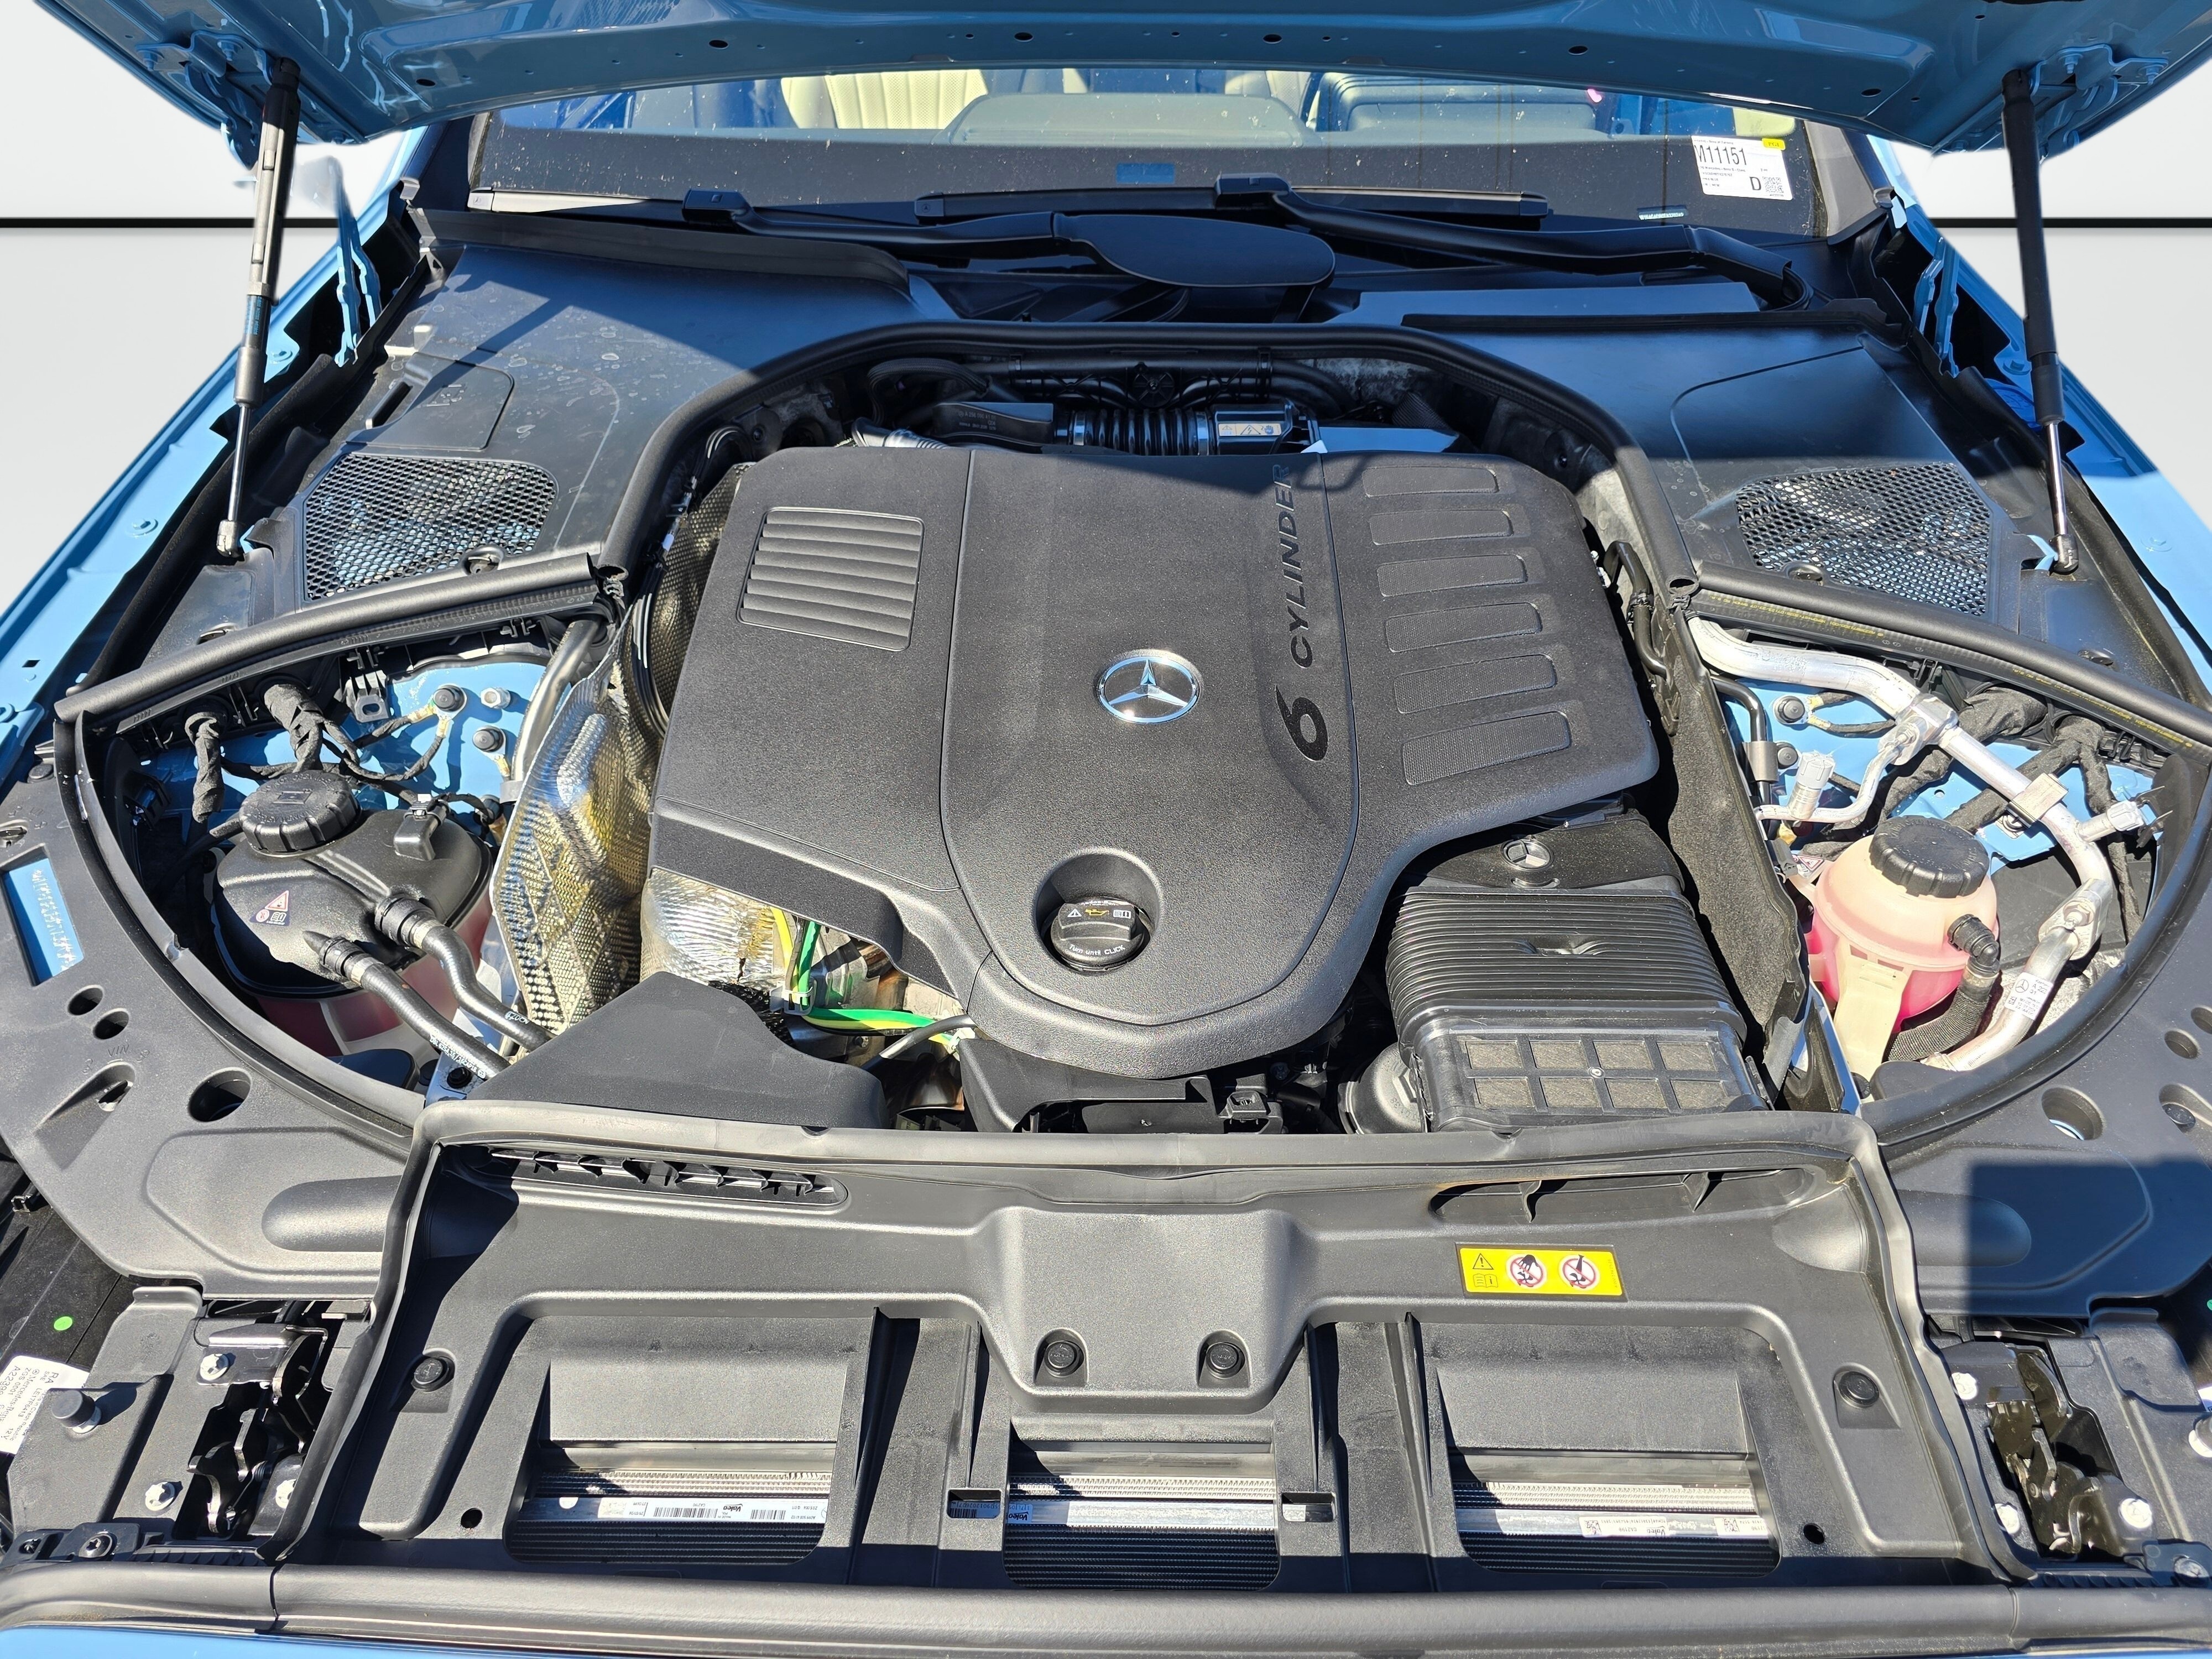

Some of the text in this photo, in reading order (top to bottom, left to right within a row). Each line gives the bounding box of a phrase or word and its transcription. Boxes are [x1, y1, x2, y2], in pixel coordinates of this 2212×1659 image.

[1749, 176, 1761, 191] D
[1272, 463, 1328, 762] 6 CYLINDER
[1069, 943, 1083, 954] Turn
[1104, 945, 1126, 955] CLICK
[107, 1043, 129, 1057] VIN
[7, 1366, 32, 1395] ZGS 0001
[44, 1371, 59, 1384] RA
[1008, 1512, 1028, 1521] Valeo
